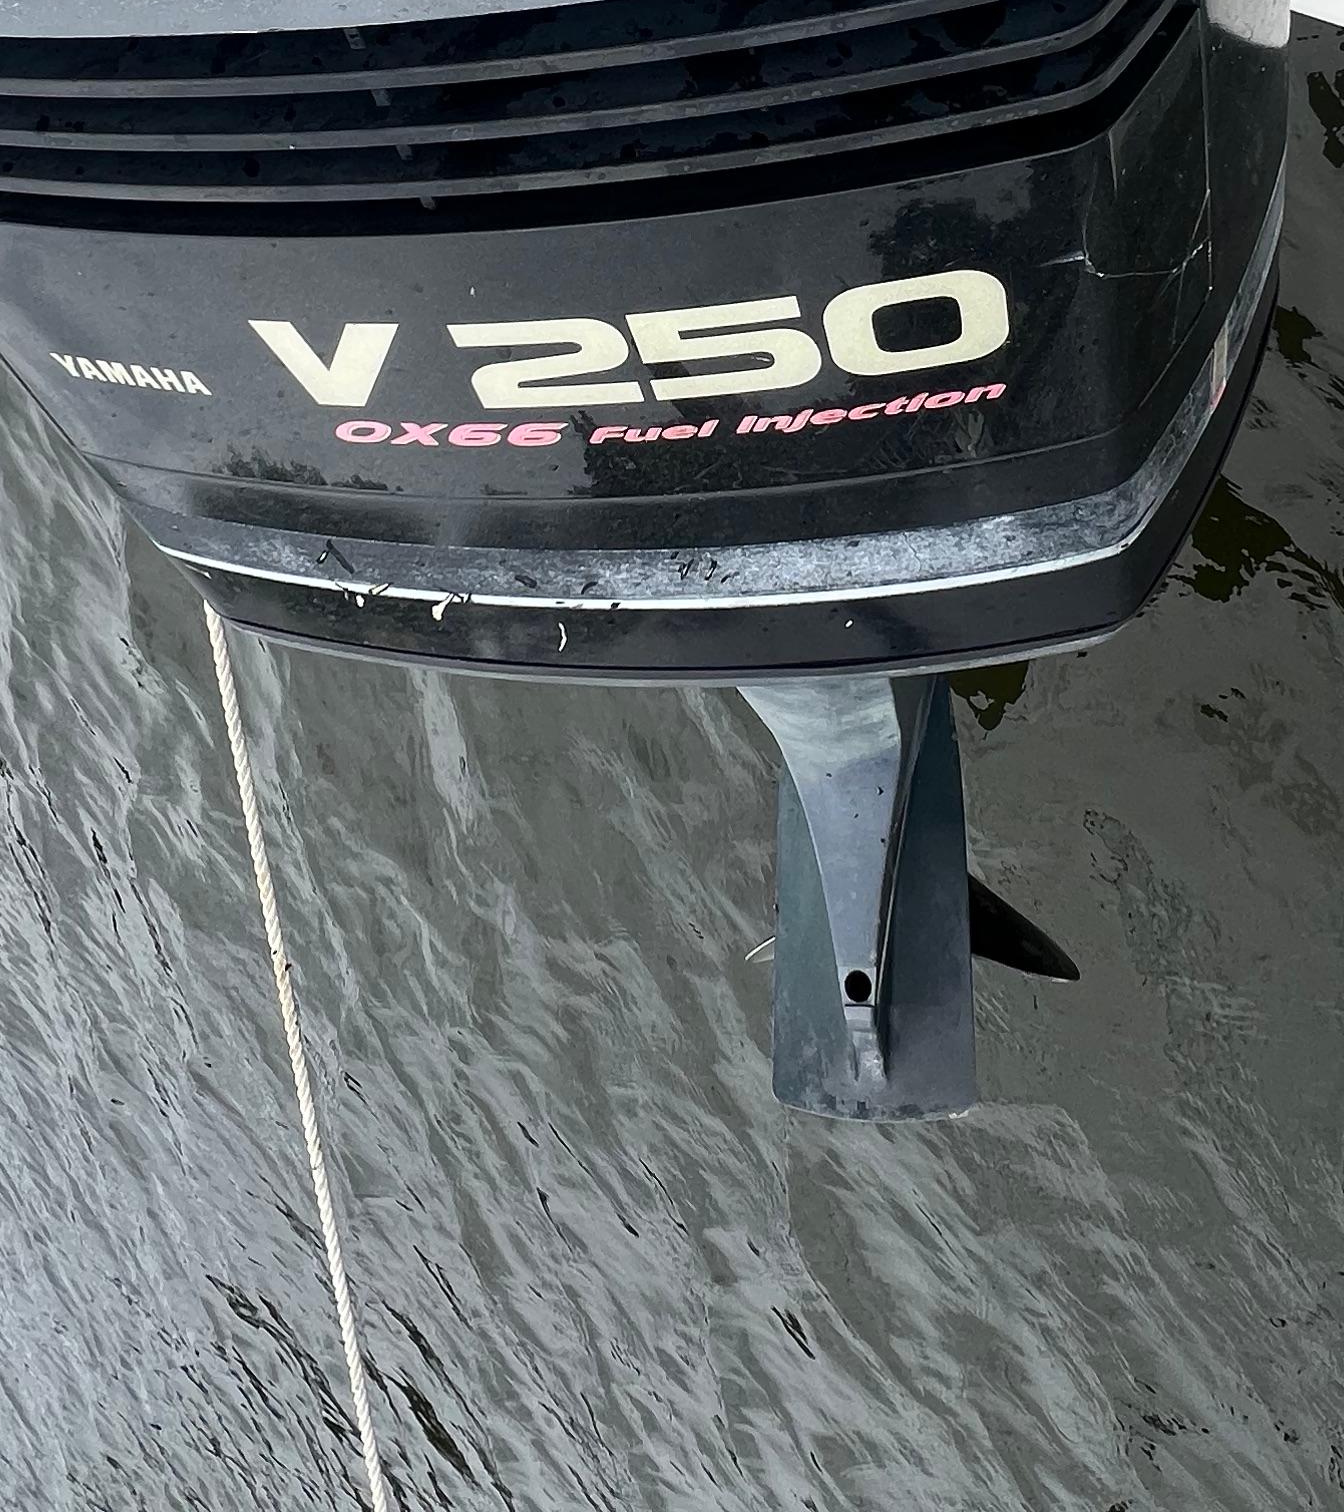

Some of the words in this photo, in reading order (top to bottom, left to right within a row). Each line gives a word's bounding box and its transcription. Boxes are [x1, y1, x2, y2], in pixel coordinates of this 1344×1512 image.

[247, 318, 400, 408] V
[446, 268, 1010, 409] 250
[48, 351, 213, 396] YAMAHA
[335, 419, 570, 447] OX66
[588, 418, 719, 445] Fuel
[735, 382, 1008, 435] Injection
